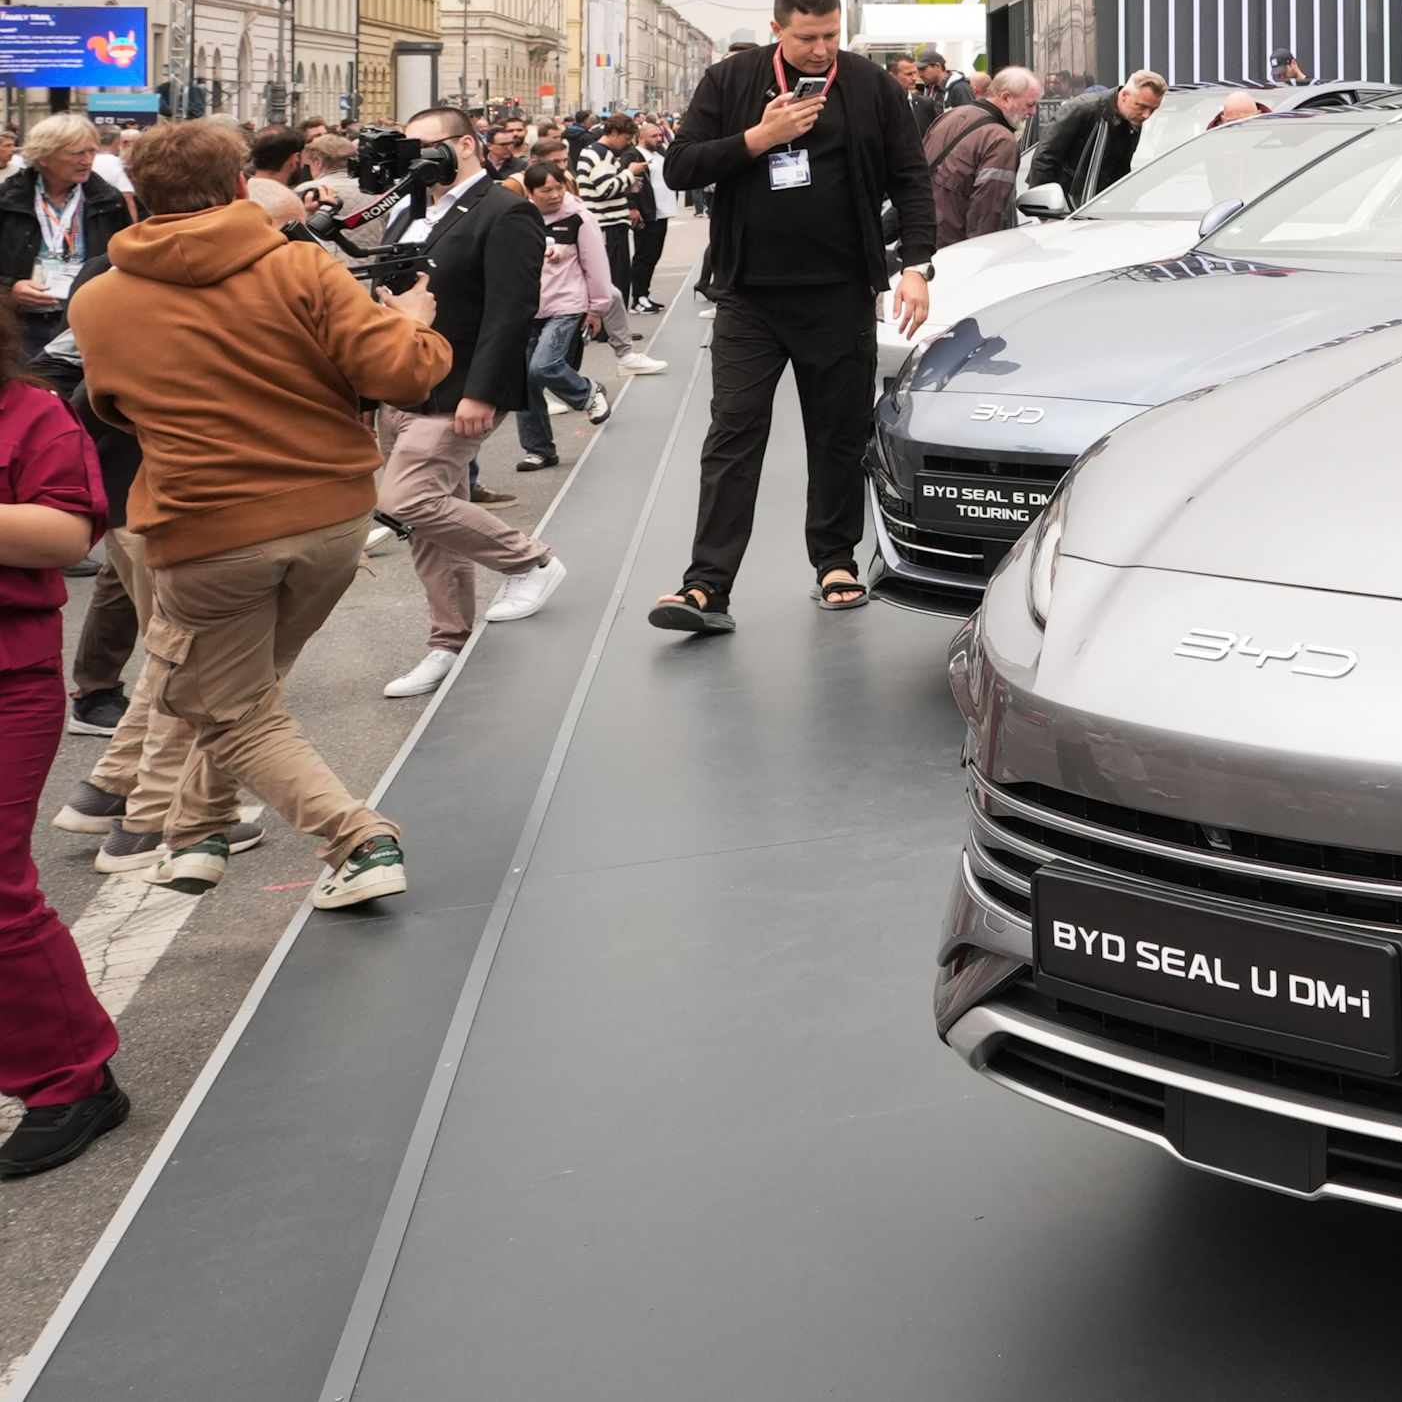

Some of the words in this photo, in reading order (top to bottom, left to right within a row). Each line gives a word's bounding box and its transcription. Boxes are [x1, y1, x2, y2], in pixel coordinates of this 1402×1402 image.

[361, 191, 400, 221] RONIN
[970, 403, 1046, 425] BYD
[922, 485, 958, 499] BYD
[961, 488, 1009, 503] SEAL
[1012, 492, 1025, 505] 6
[956, 504, 1030, 522] TOURING
[1174, 626, 1359, 680] BYD
[1052, 920, 1127, 964] BYD
[1135, 940, 1241, 990] SEAL
[1250, 966, 1278, 998] U
[1289, 973, 1371, 1019] DM-i
